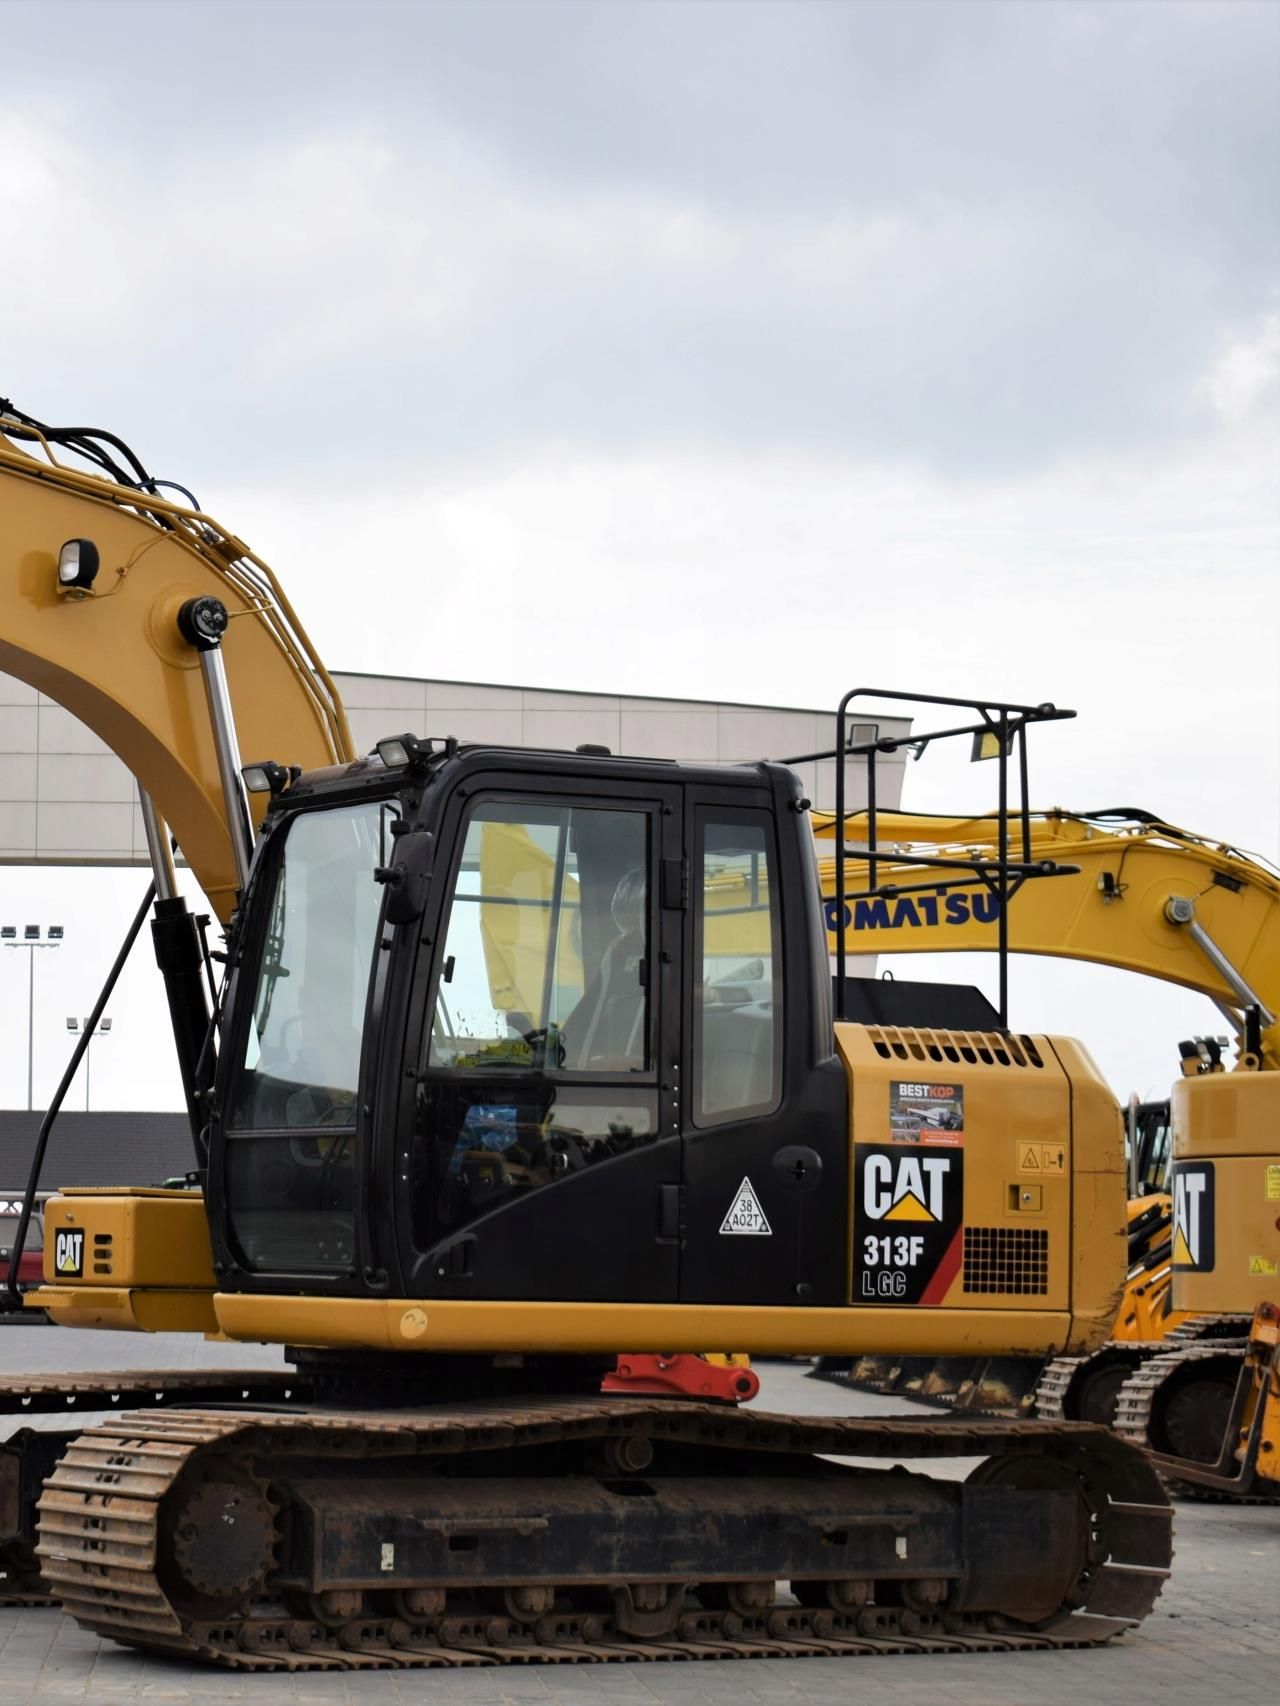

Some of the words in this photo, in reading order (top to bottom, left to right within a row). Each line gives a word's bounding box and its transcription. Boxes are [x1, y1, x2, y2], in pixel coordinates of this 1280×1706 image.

[824, 888, 1000, 932] OMATSU
[899, 1083, 954, 1098] BESTKOP
[864, 1154, 950, 1222] CAT
[1173, 1172, 1206, 1265] AT
[56, 1233, 83, 1270] CAT
[863, 1235, 924, 1266] 313F
[862, 1270, 875, 1296] L
[877, 1270, 906, 1296] GC
